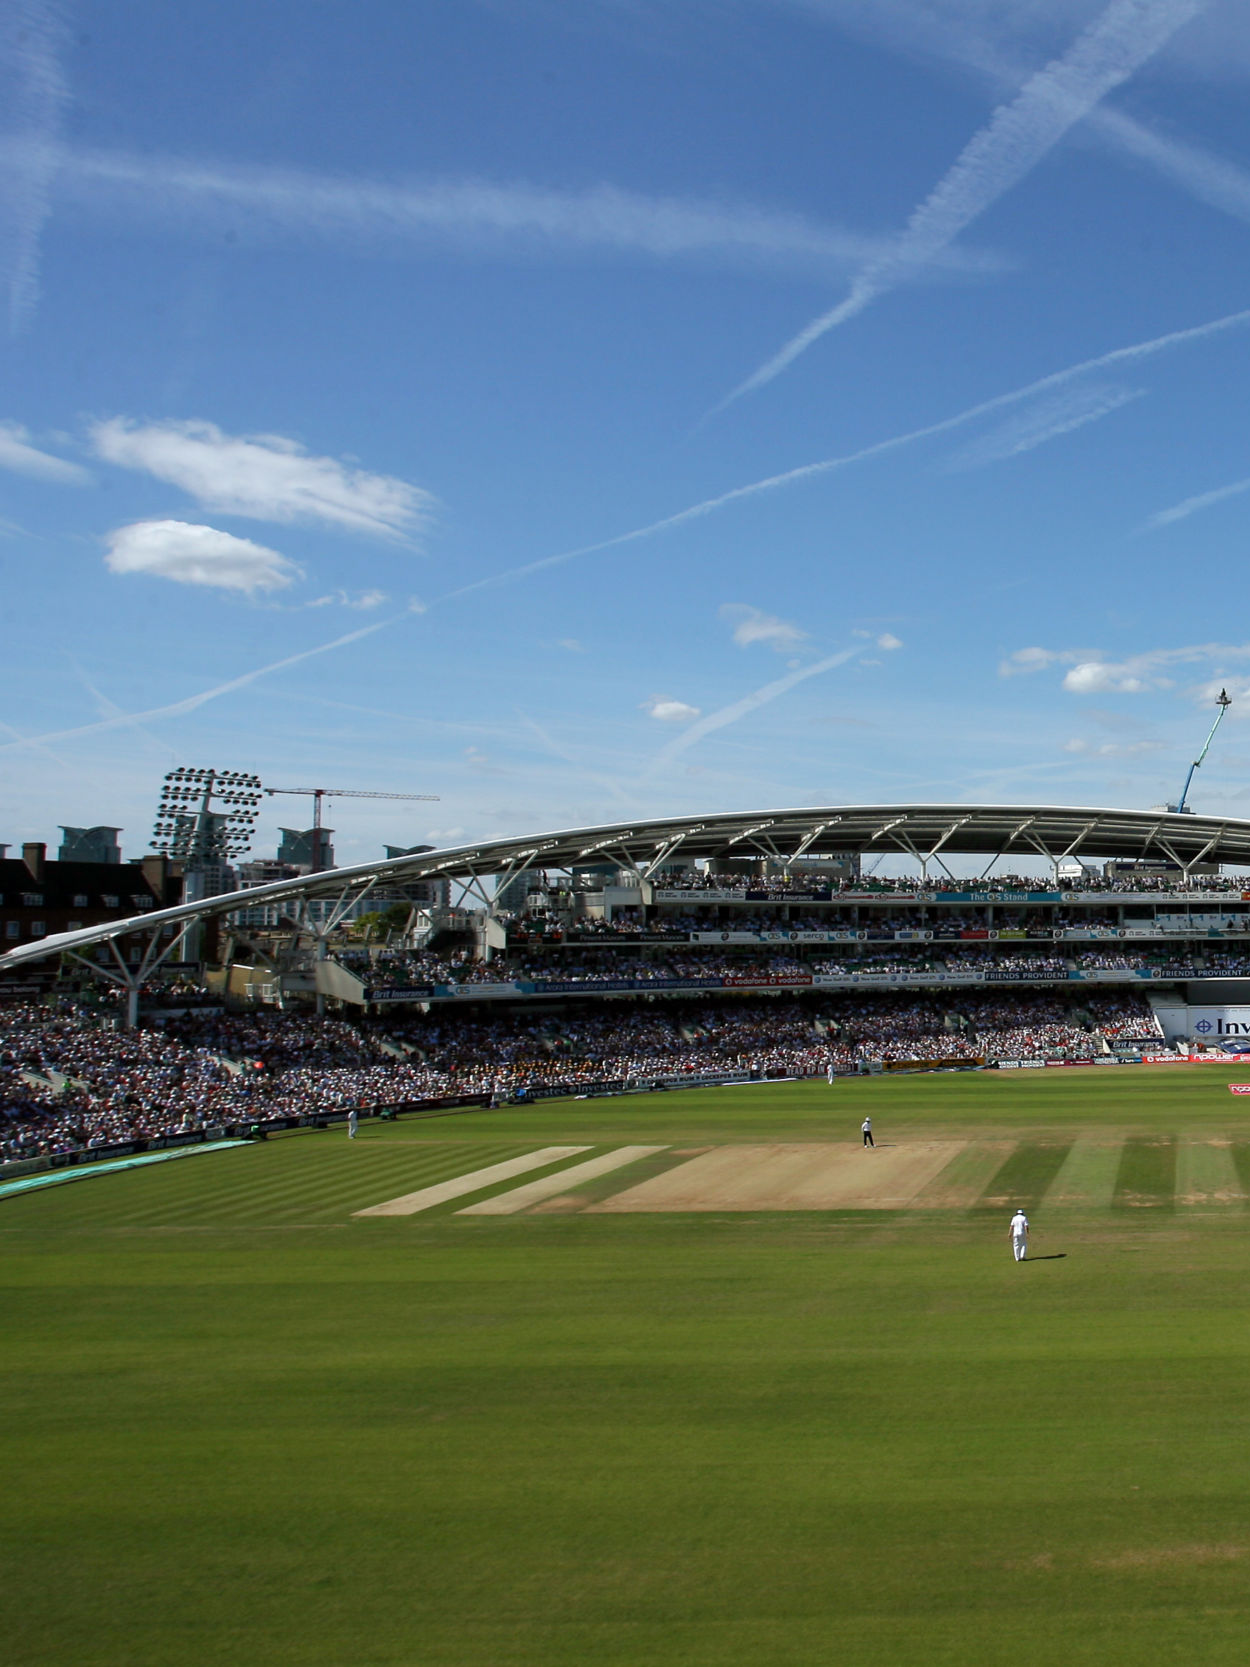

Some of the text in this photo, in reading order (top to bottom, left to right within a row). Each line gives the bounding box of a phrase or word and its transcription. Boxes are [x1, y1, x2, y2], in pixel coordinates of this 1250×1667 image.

[970, 892, 984, 900] The
[1004, 892, 1028, 900] Stand
[373, 990, 428, 998] Brit Insurance
[578, 1080, 624, 1092] Investec
